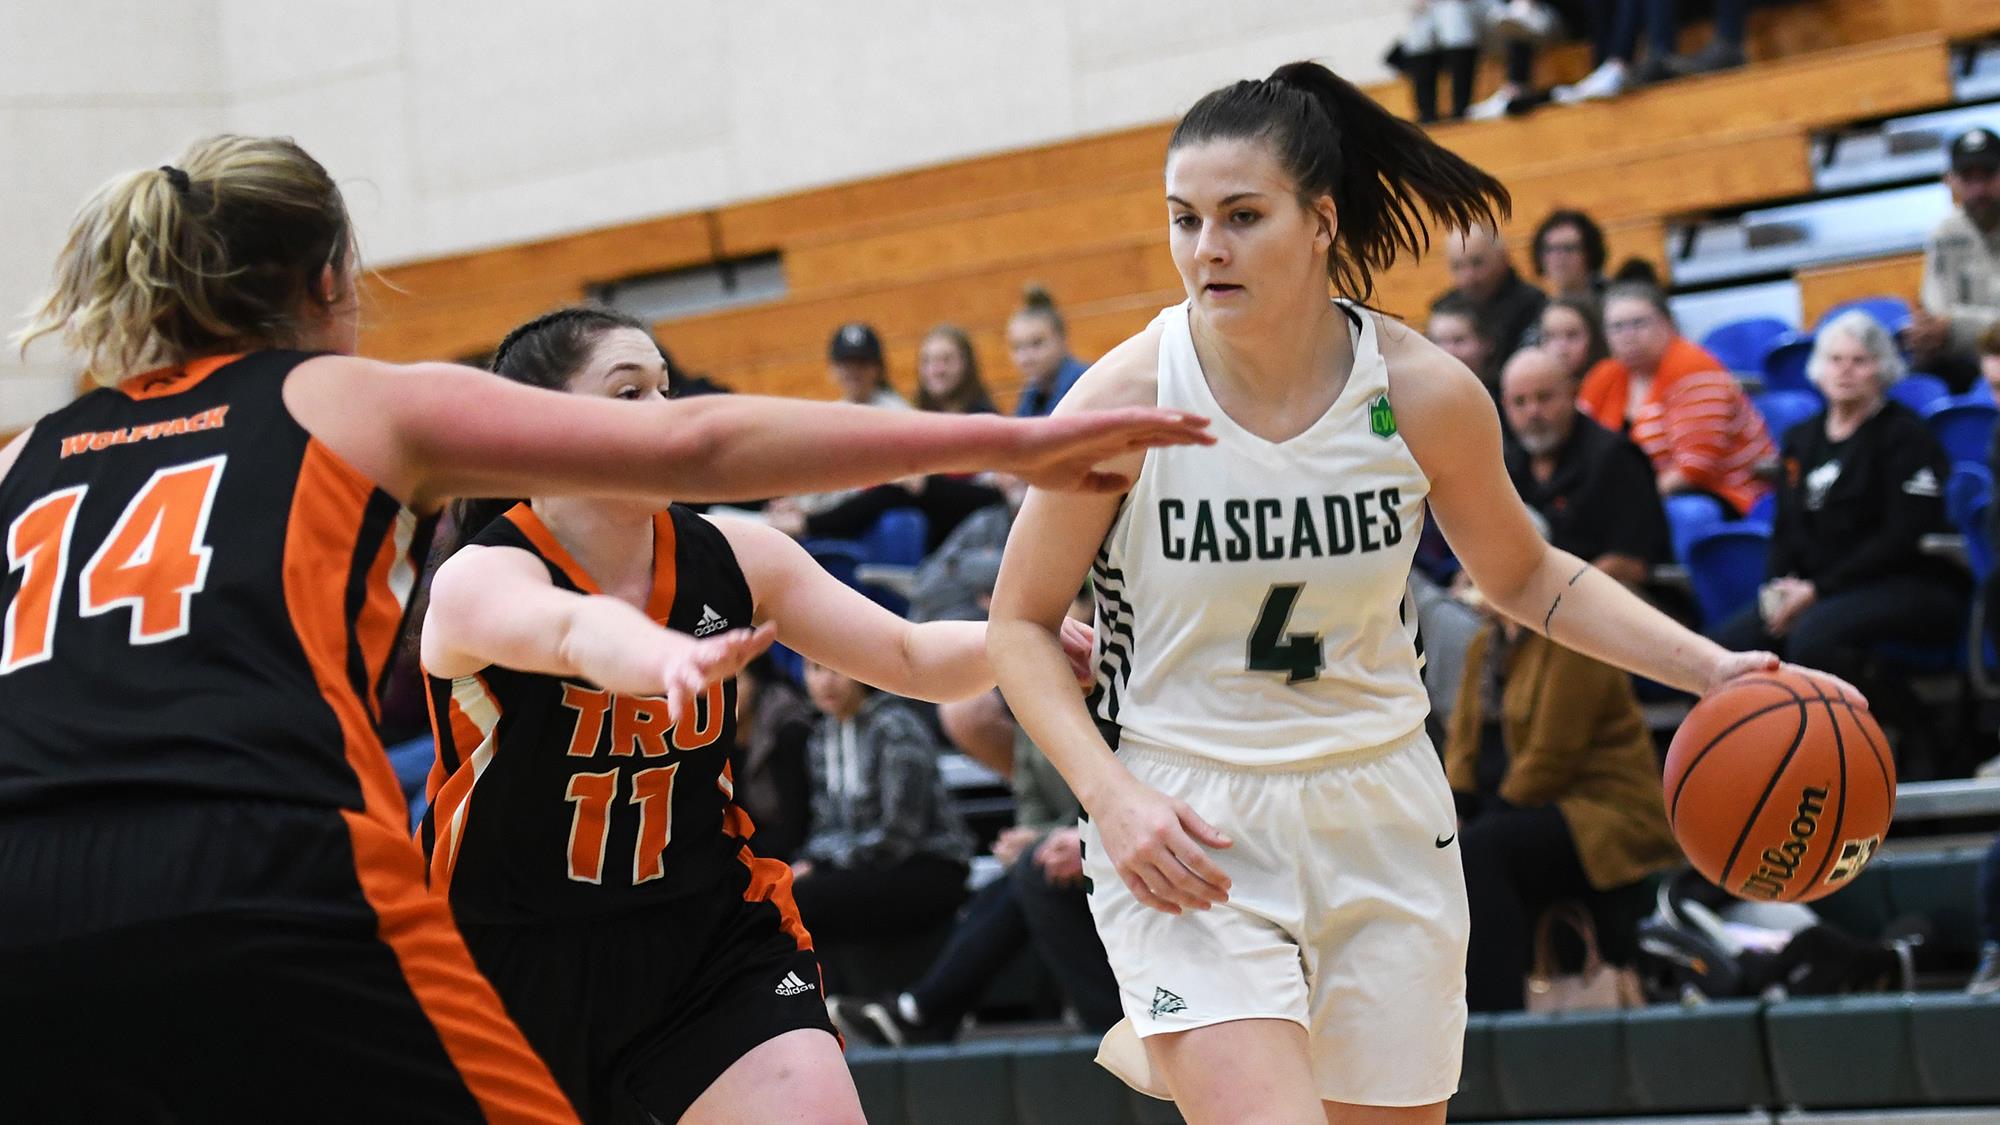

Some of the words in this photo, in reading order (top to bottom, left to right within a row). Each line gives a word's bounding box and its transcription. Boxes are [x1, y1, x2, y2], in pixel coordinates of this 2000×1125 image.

[60, 405, 229, 459] WOLFPACK
[1159, 487, 1403, 563] CASCADES
[0, 454, 228, 675] 14
[694, 618, 728, 636] adidas
[1244, 581, 1326, 685] 4
[561, 678, 725, 758] TRU
[564, 762, 680, 885] 11
[775, 983, 815, 996] adidas
